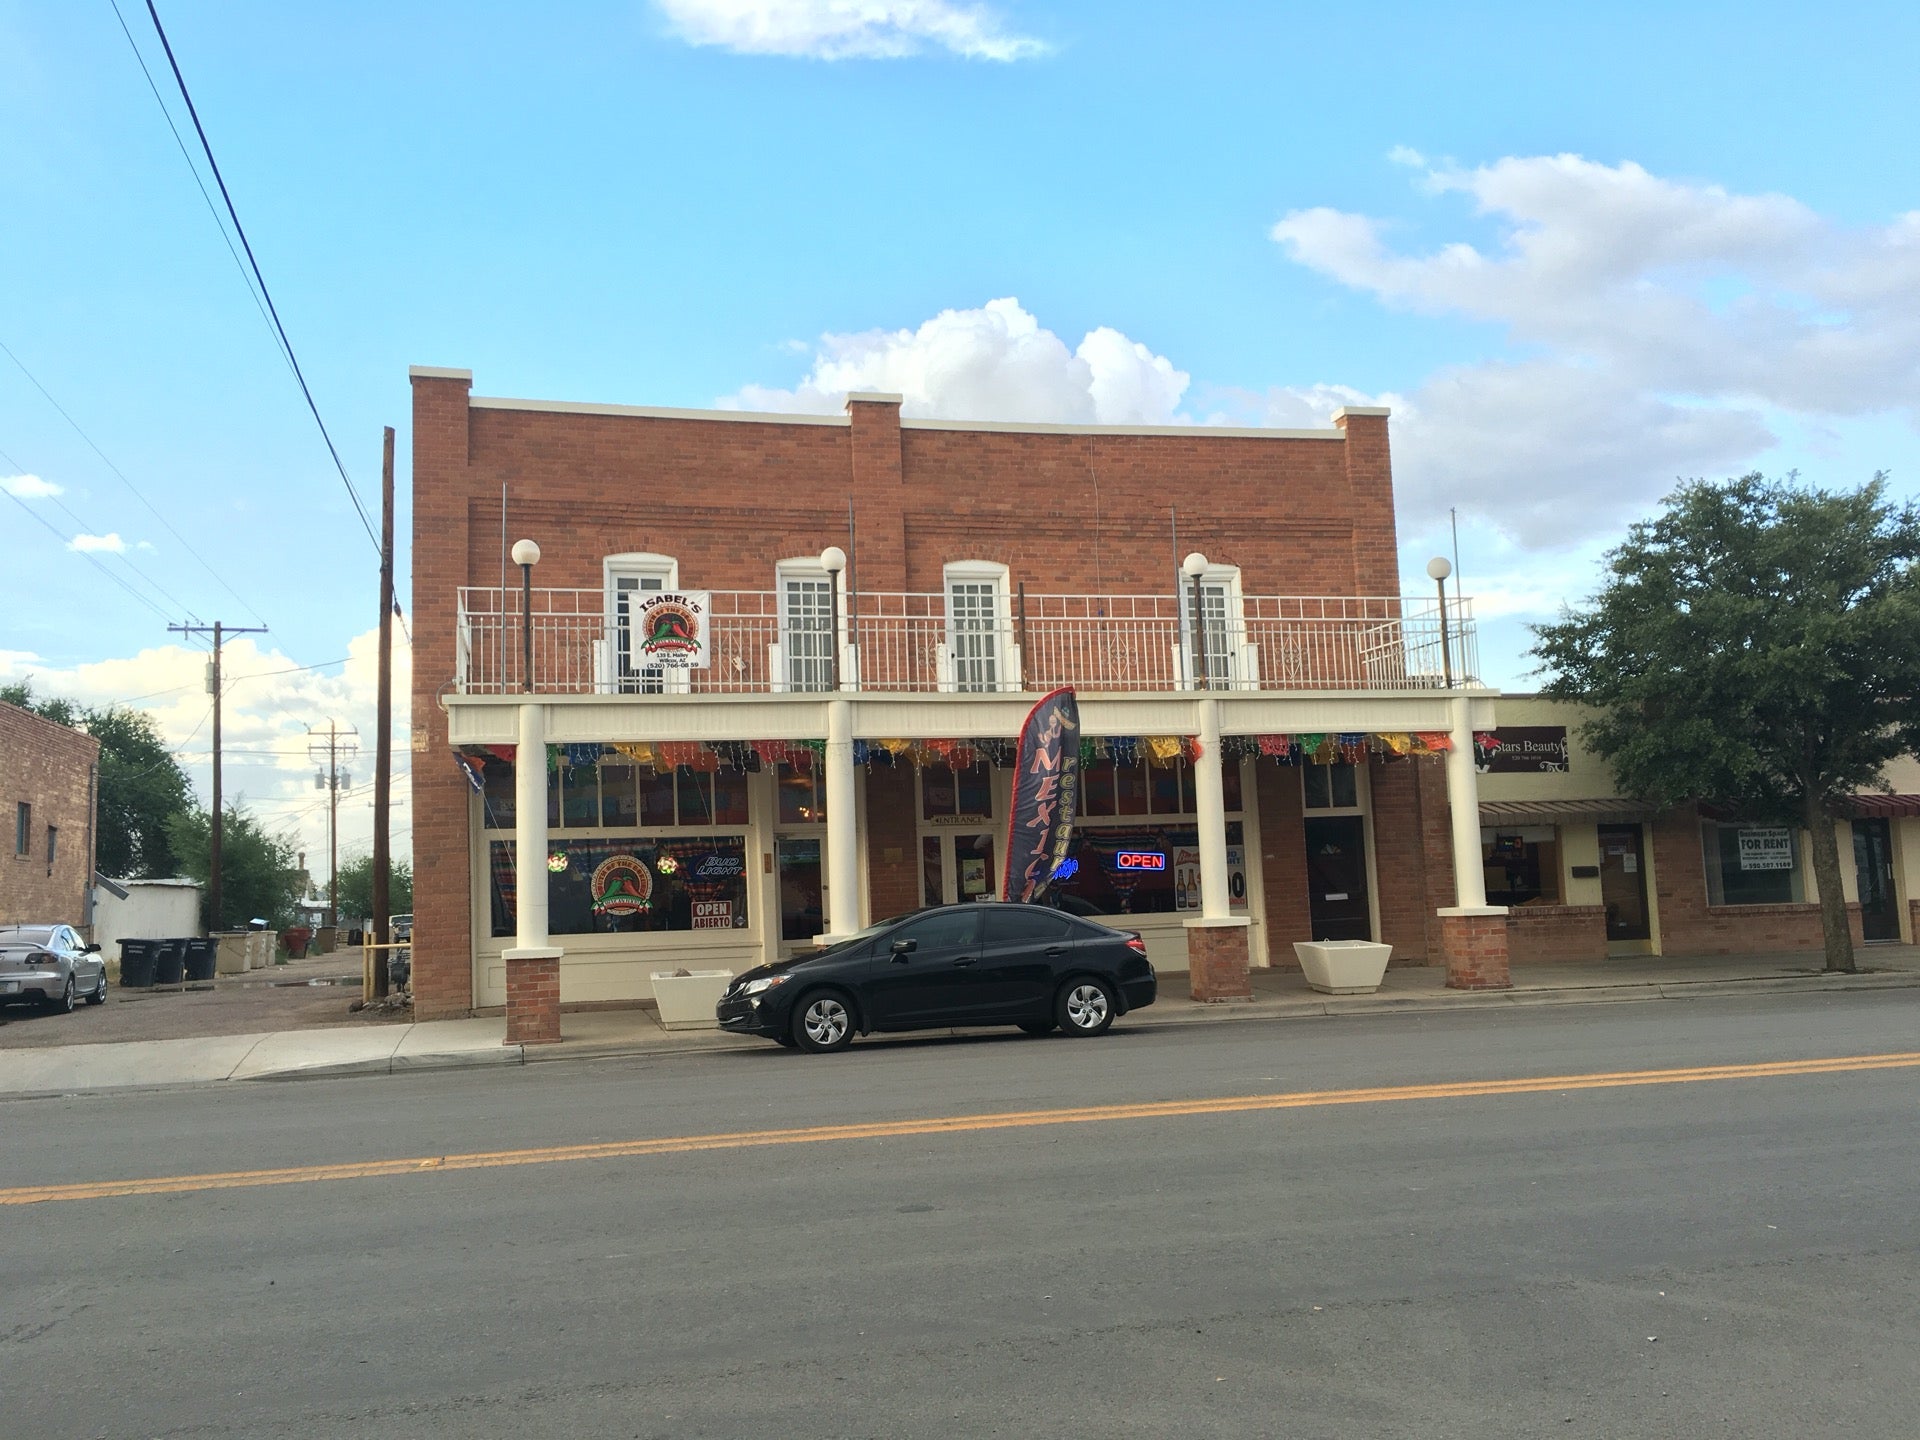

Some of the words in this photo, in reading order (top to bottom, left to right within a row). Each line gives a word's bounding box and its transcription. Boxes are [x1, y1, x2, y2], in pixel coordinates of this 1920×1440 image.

[639, 594, 702, 614] ISABEL'S
[1524, 740, 1561, 754] Beauty
[940, 816, 982, 824] ENTRANCE
[1741, 839, 1761, 849] FOR
[1764, 838, 1788, 849] RENT
[705, 856, 740, 866] BUD
[1119, 854, 1163, 868] OPEN
[696, 866, 743, 875] LIGHT
[696, 903, 727, 916] OPEN
[693, 917, 730, 928] ABIERTO
